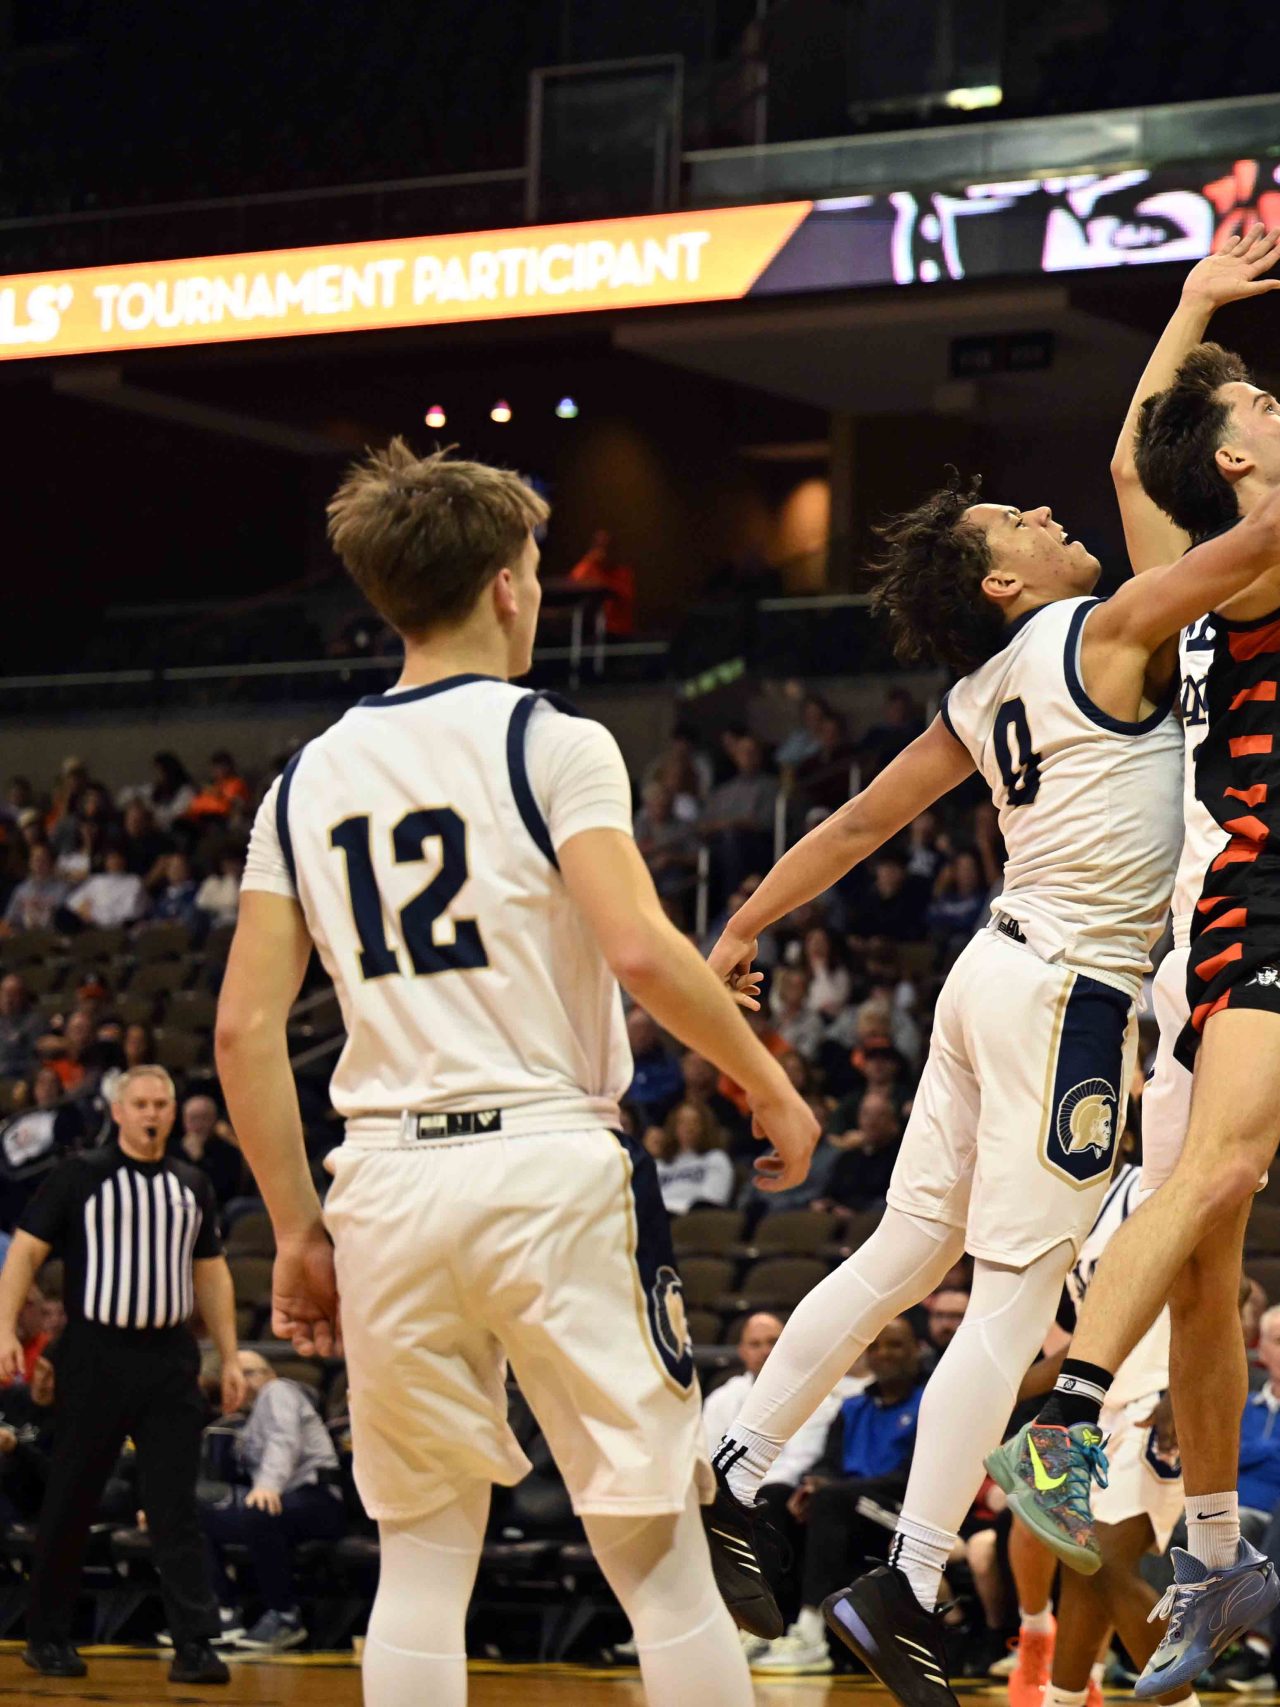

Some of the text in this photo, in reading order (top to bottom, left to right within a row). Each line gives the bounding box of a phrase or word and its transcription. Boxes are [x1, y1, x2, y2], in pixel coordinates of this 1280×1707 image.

[94, 259, 405, 333] TOURNAMENT
[413, 231, 710, 305] PARTICIPANT
[993, 696, 1042, 807] 0
[328, 804, 490, 983] 12
